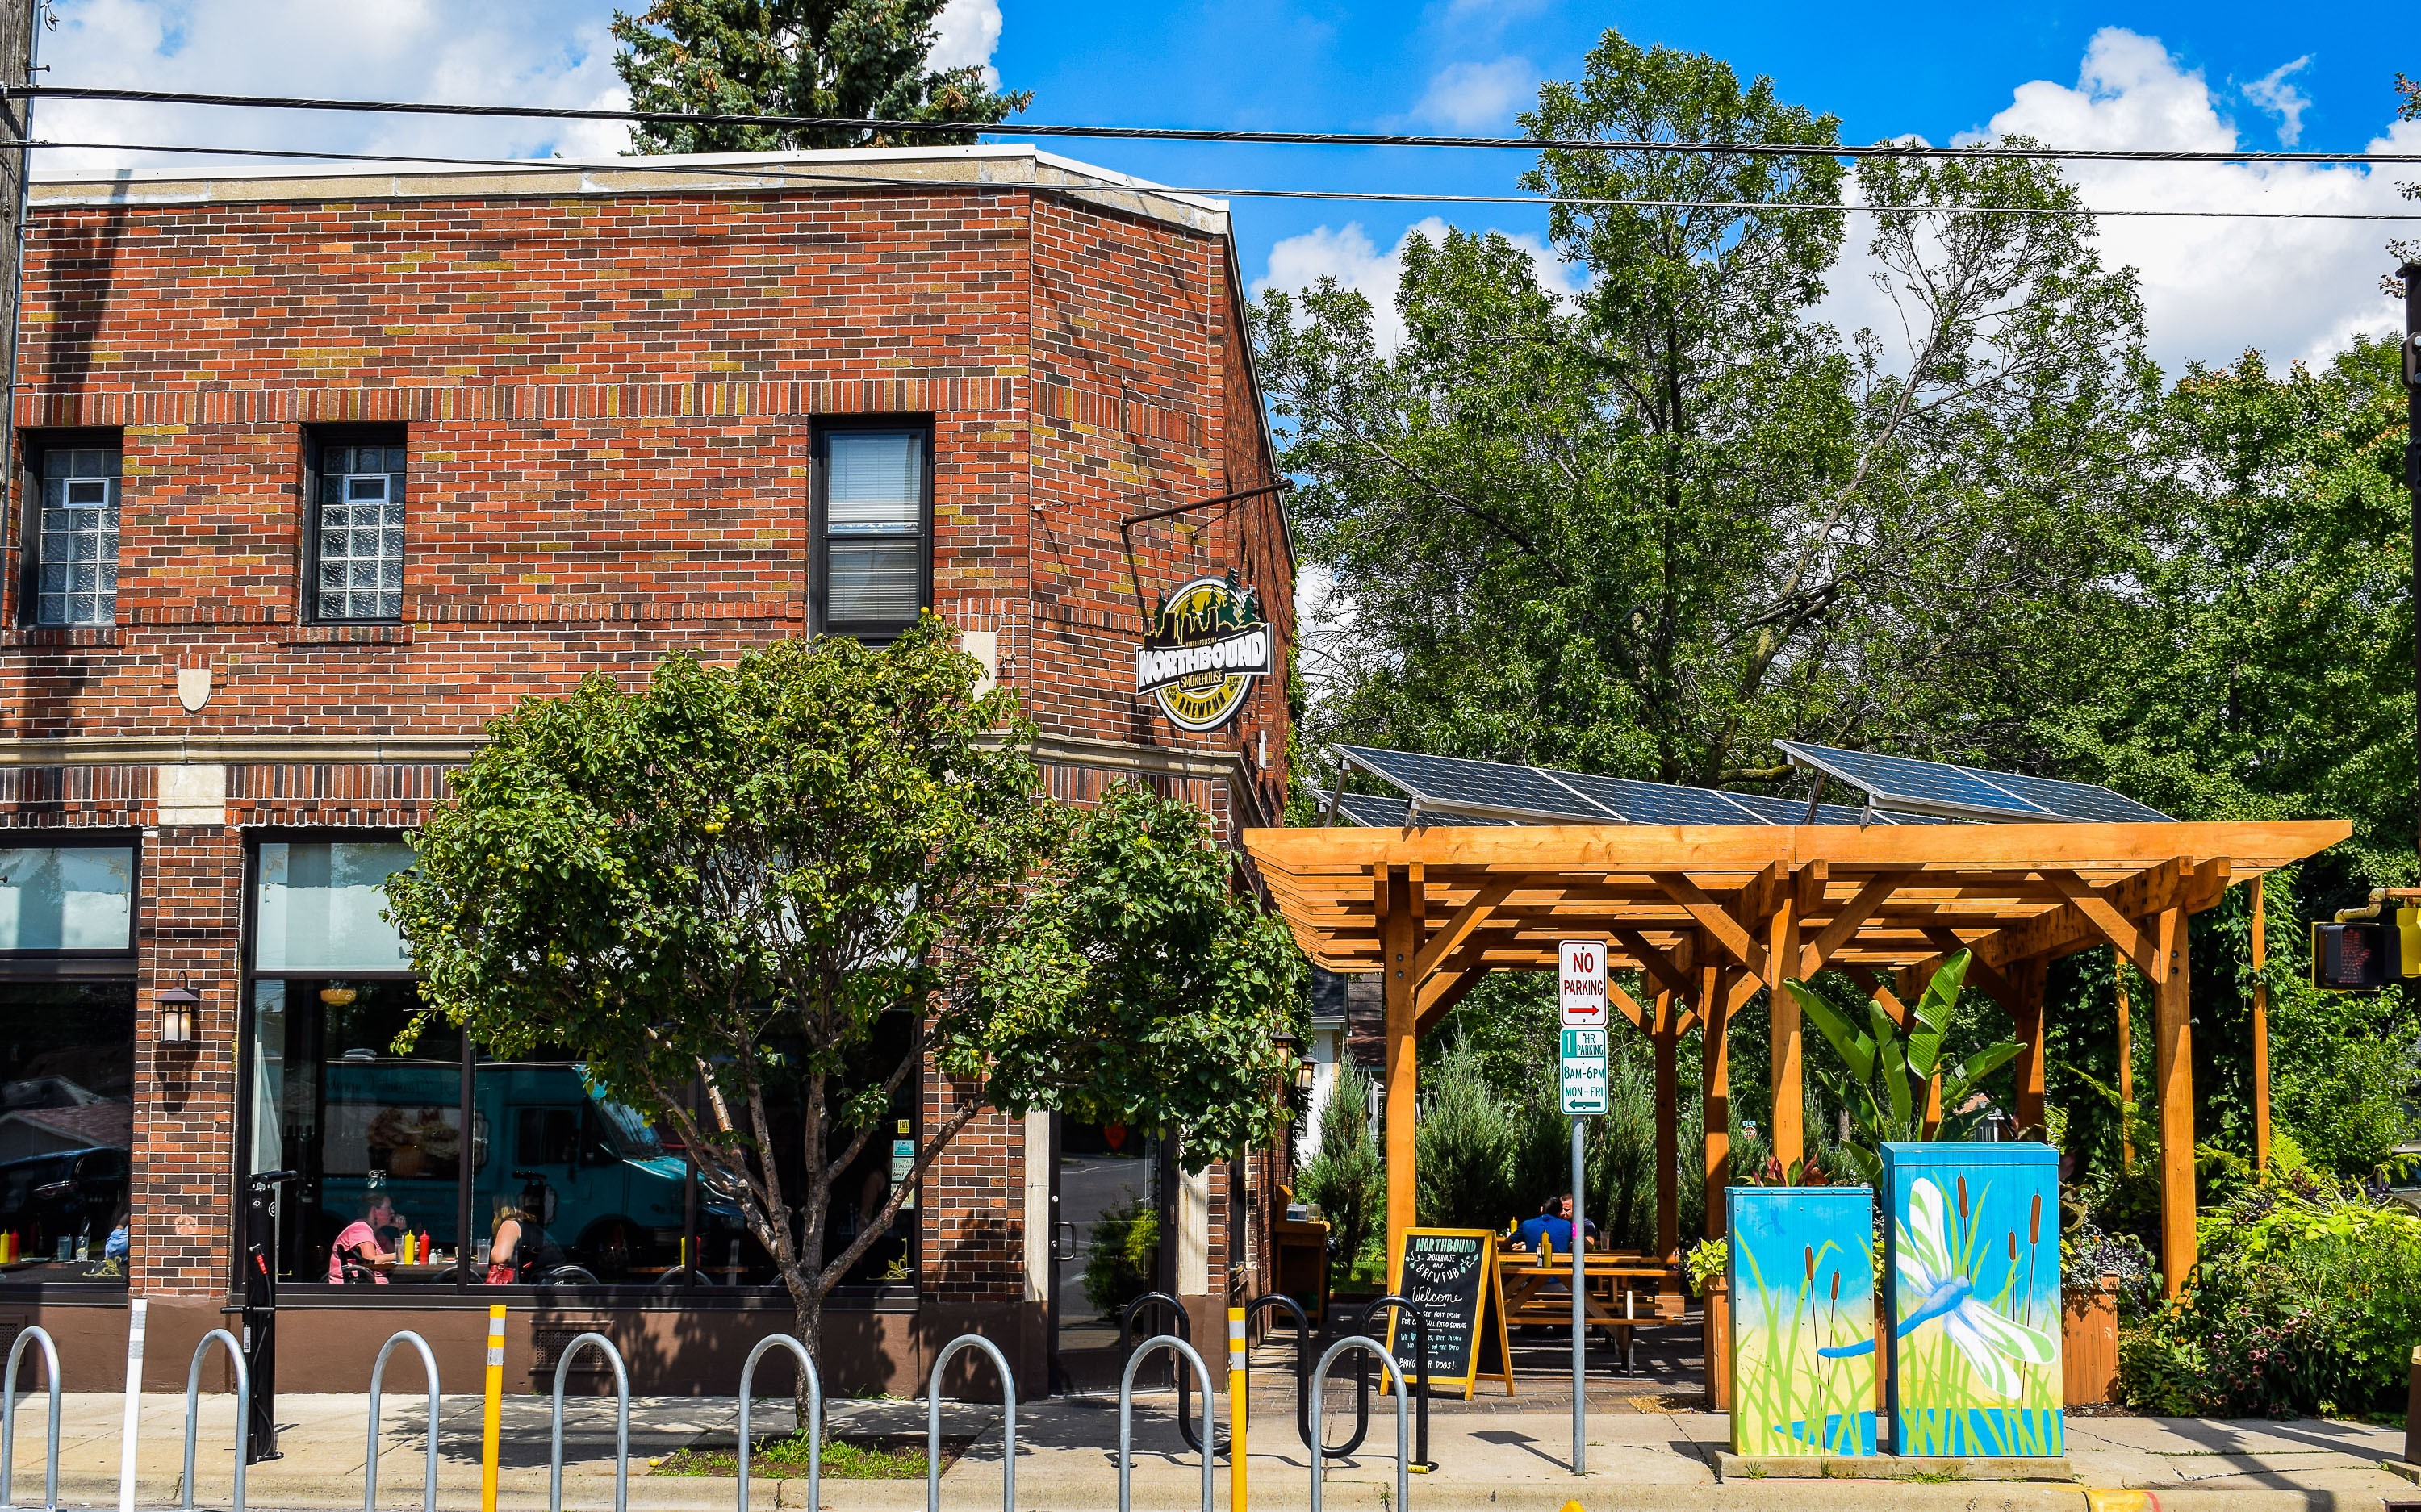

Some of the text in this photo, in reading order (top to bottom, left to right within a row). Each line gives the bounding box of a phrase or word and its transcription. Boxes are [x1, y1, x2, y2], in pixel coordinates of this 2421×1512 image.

[1138, 631, 1267, 687] NORTHBOUND
[1181, 670, 1223, 688] SMOKEHOUSE
[1177, 691, 1227, 718] BREWPUB
[1573, 952, 1594, 973] NO
[1564, 979, 1604, 996] PARKING
[1566, 1032, 1572, 1053] 1
[1584, 1034, 1595, 1044] HR
[1577, 1044, 1604, 1055] PARKING
[1564, 1066, 1604, 1080] 8AM-6PM
[1415, 1238, 1477, 1253] NORTHBOUND
[1427, 1254, 1456, 1263] SMOKEHOUSE
[1411, 1285, 1463, 1303] Welcome
[1400, 1333, 1408, 1341] WE
[1399, 1357, 1416, 1368] BRING
[1436, 1360, 1455, 1371] DOGS!
